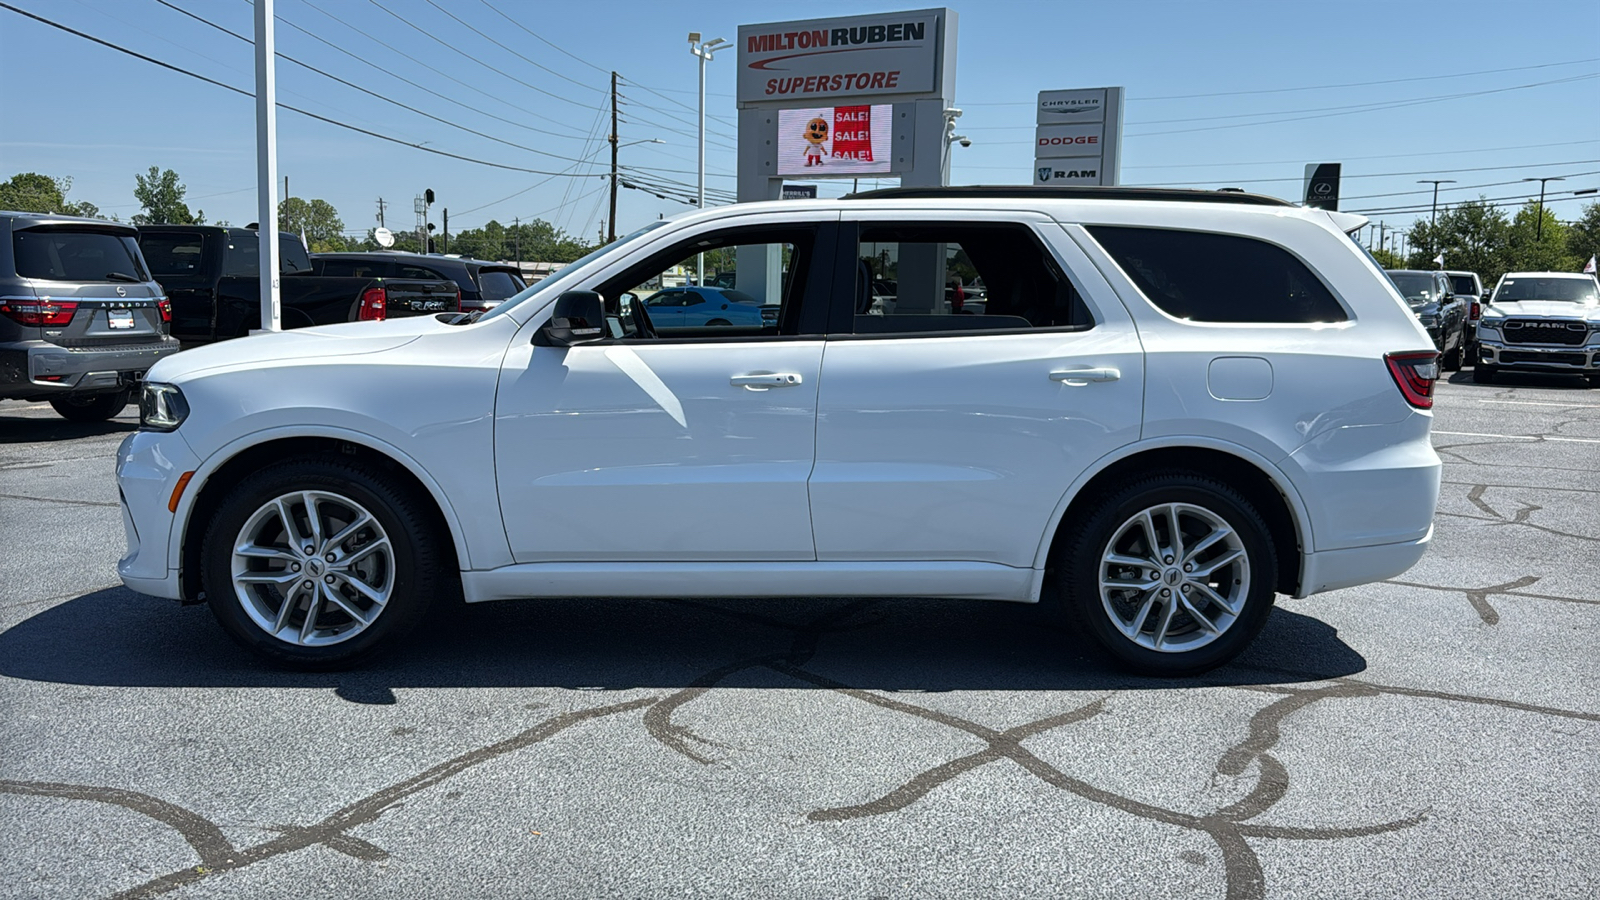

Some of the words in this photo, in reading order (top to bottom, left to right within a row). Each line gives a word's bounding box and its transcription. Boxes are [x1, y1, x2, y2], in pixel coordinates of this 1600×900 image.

[748, 30, 828, 53] MILTON
[831, 22, 925, 46] RUBEN
[765, 71, 900, 95] SUPERSTORE
[1042, 99, 1099, 107] CHRYSLER
[835, 111, 869, 122] SALE!
[835, 131, 869, 141] SALE!
[1039, 136, 1098, 146] DODGE
[834, 150, 870, 161] SALE!
[1054, 170, 1096, 178] RAM
[411, 301, 447, 311] RAM
